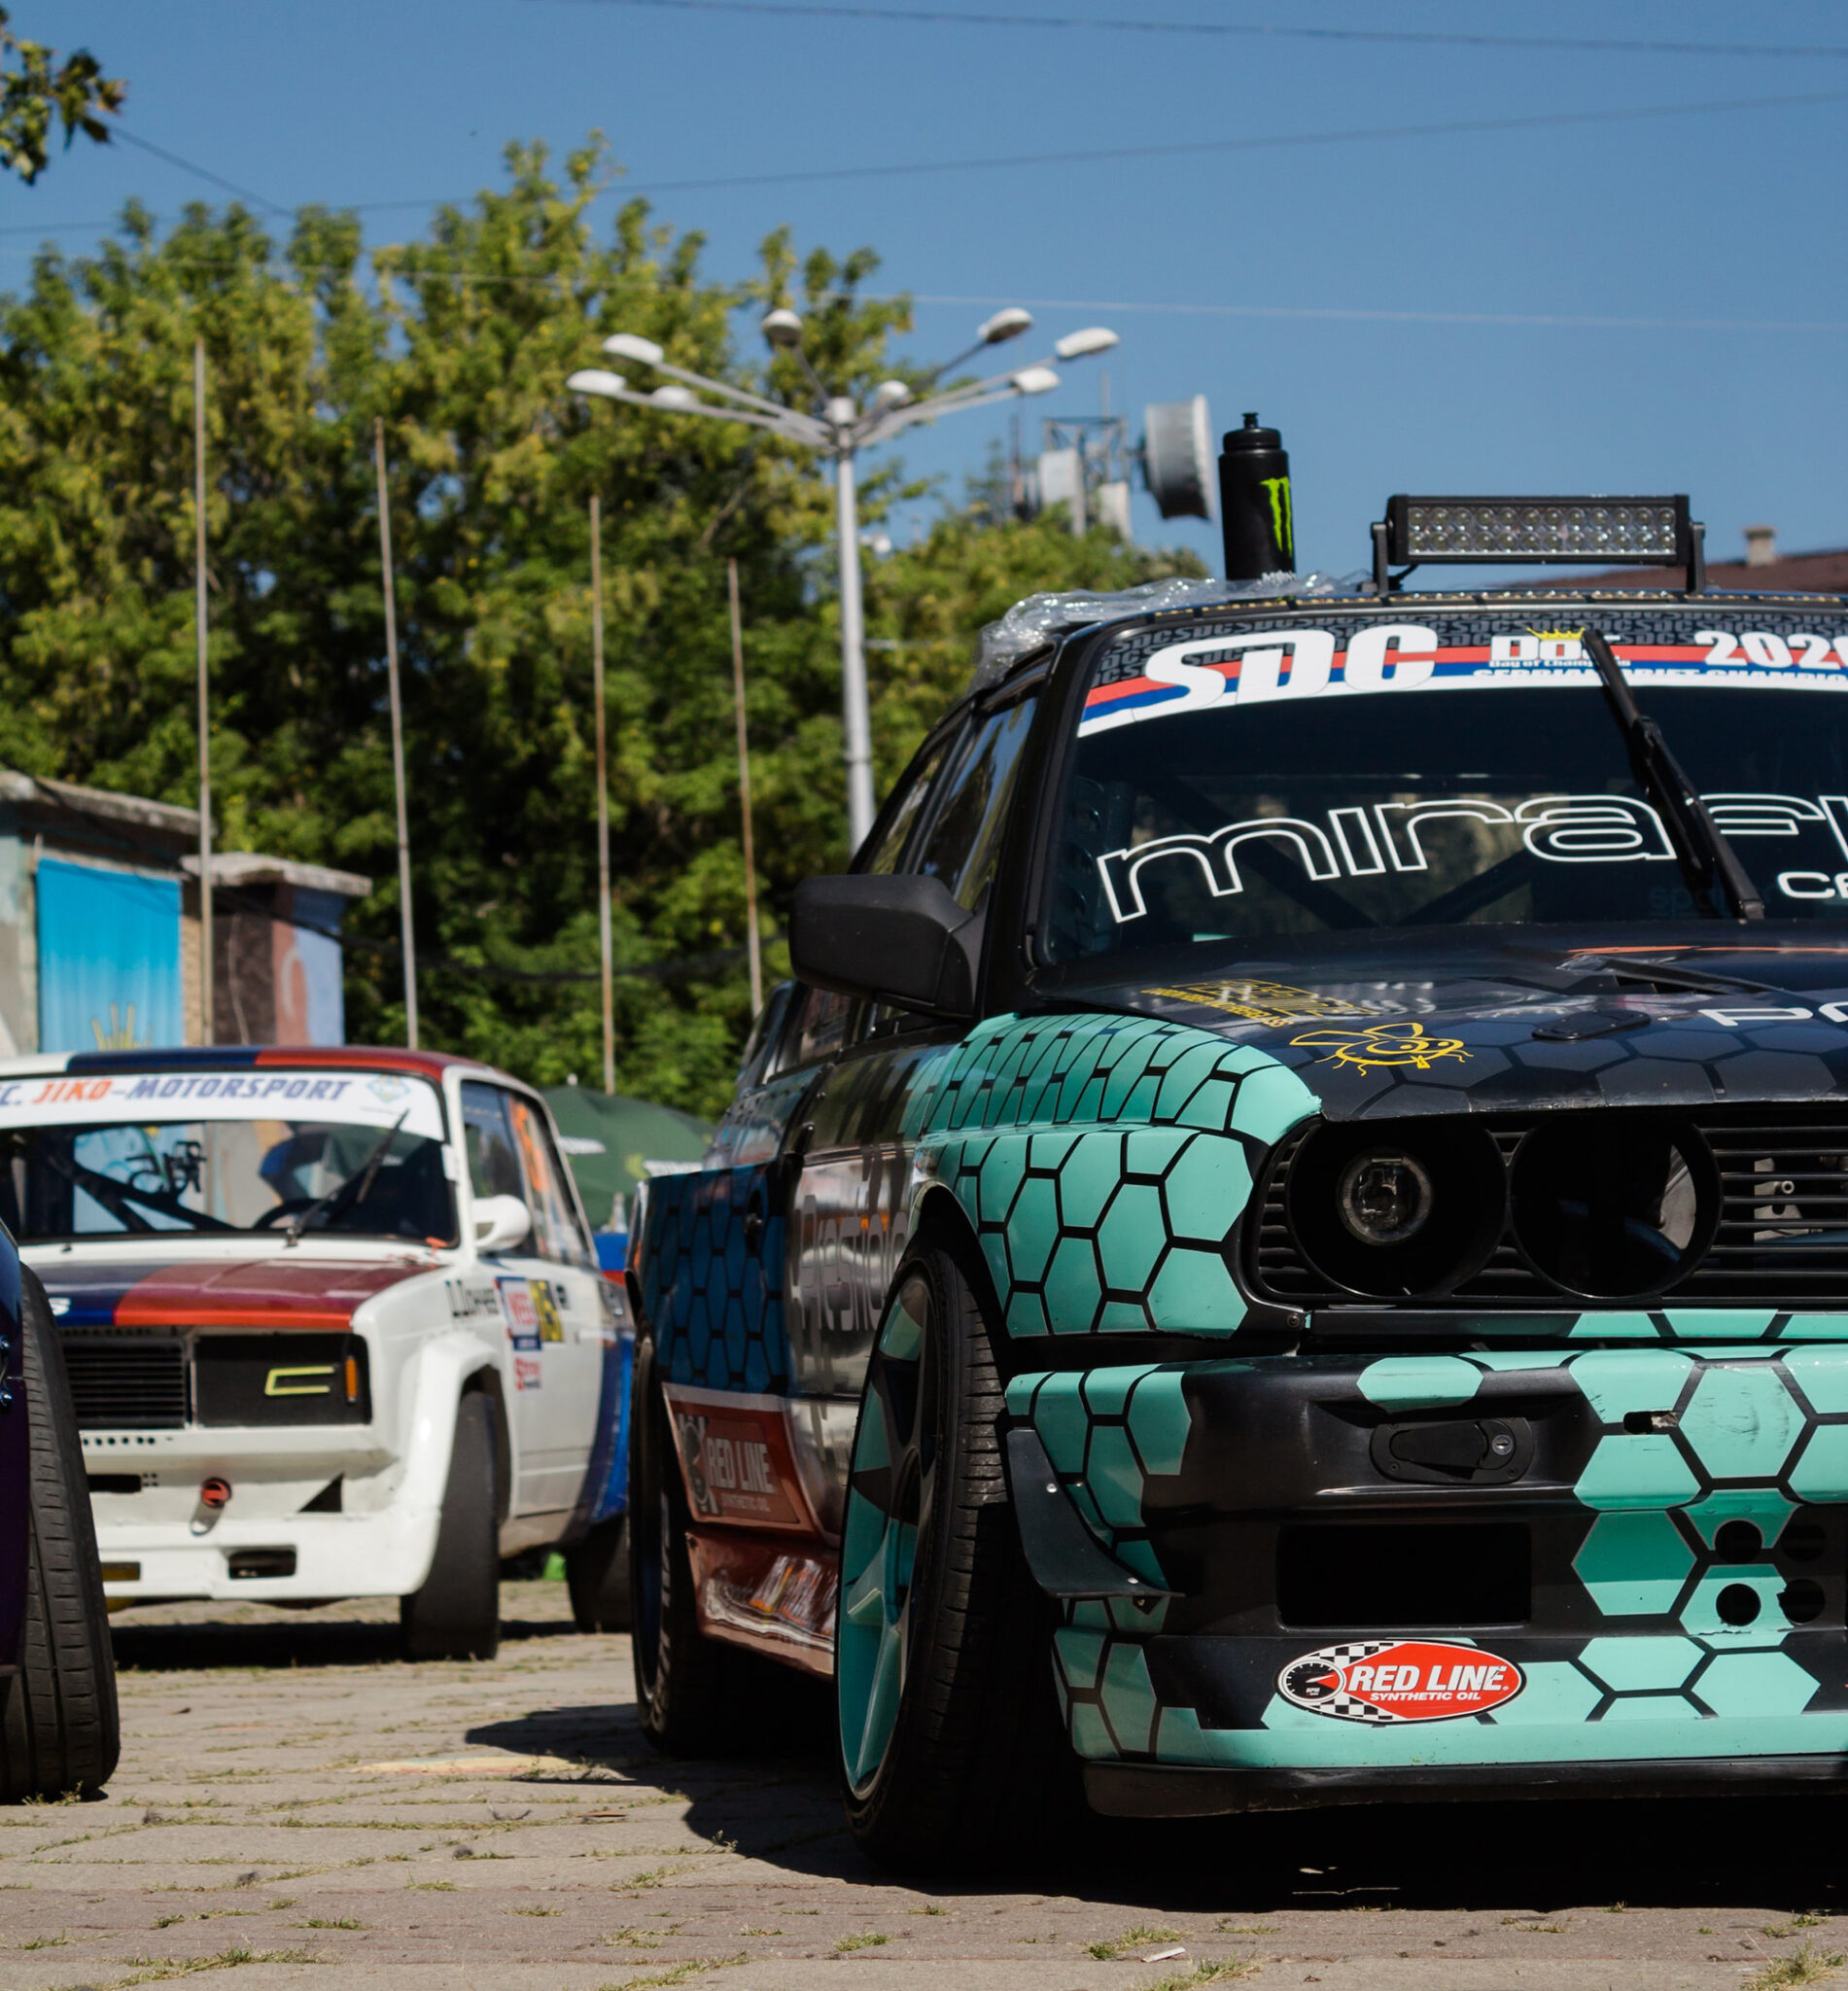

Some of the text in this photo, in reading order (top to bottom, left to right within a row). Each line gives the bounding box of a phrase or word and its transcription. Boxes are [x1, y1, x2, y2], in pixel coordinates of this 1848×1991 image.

[1133, 624, 1439, 721] SDC
[706, 1436, 776, 1495] RED LINE
[1347, 1664, 1508, 1693] RED LINE
[1370, 1692, 1482, 1701] SYNTHETIC OIL
